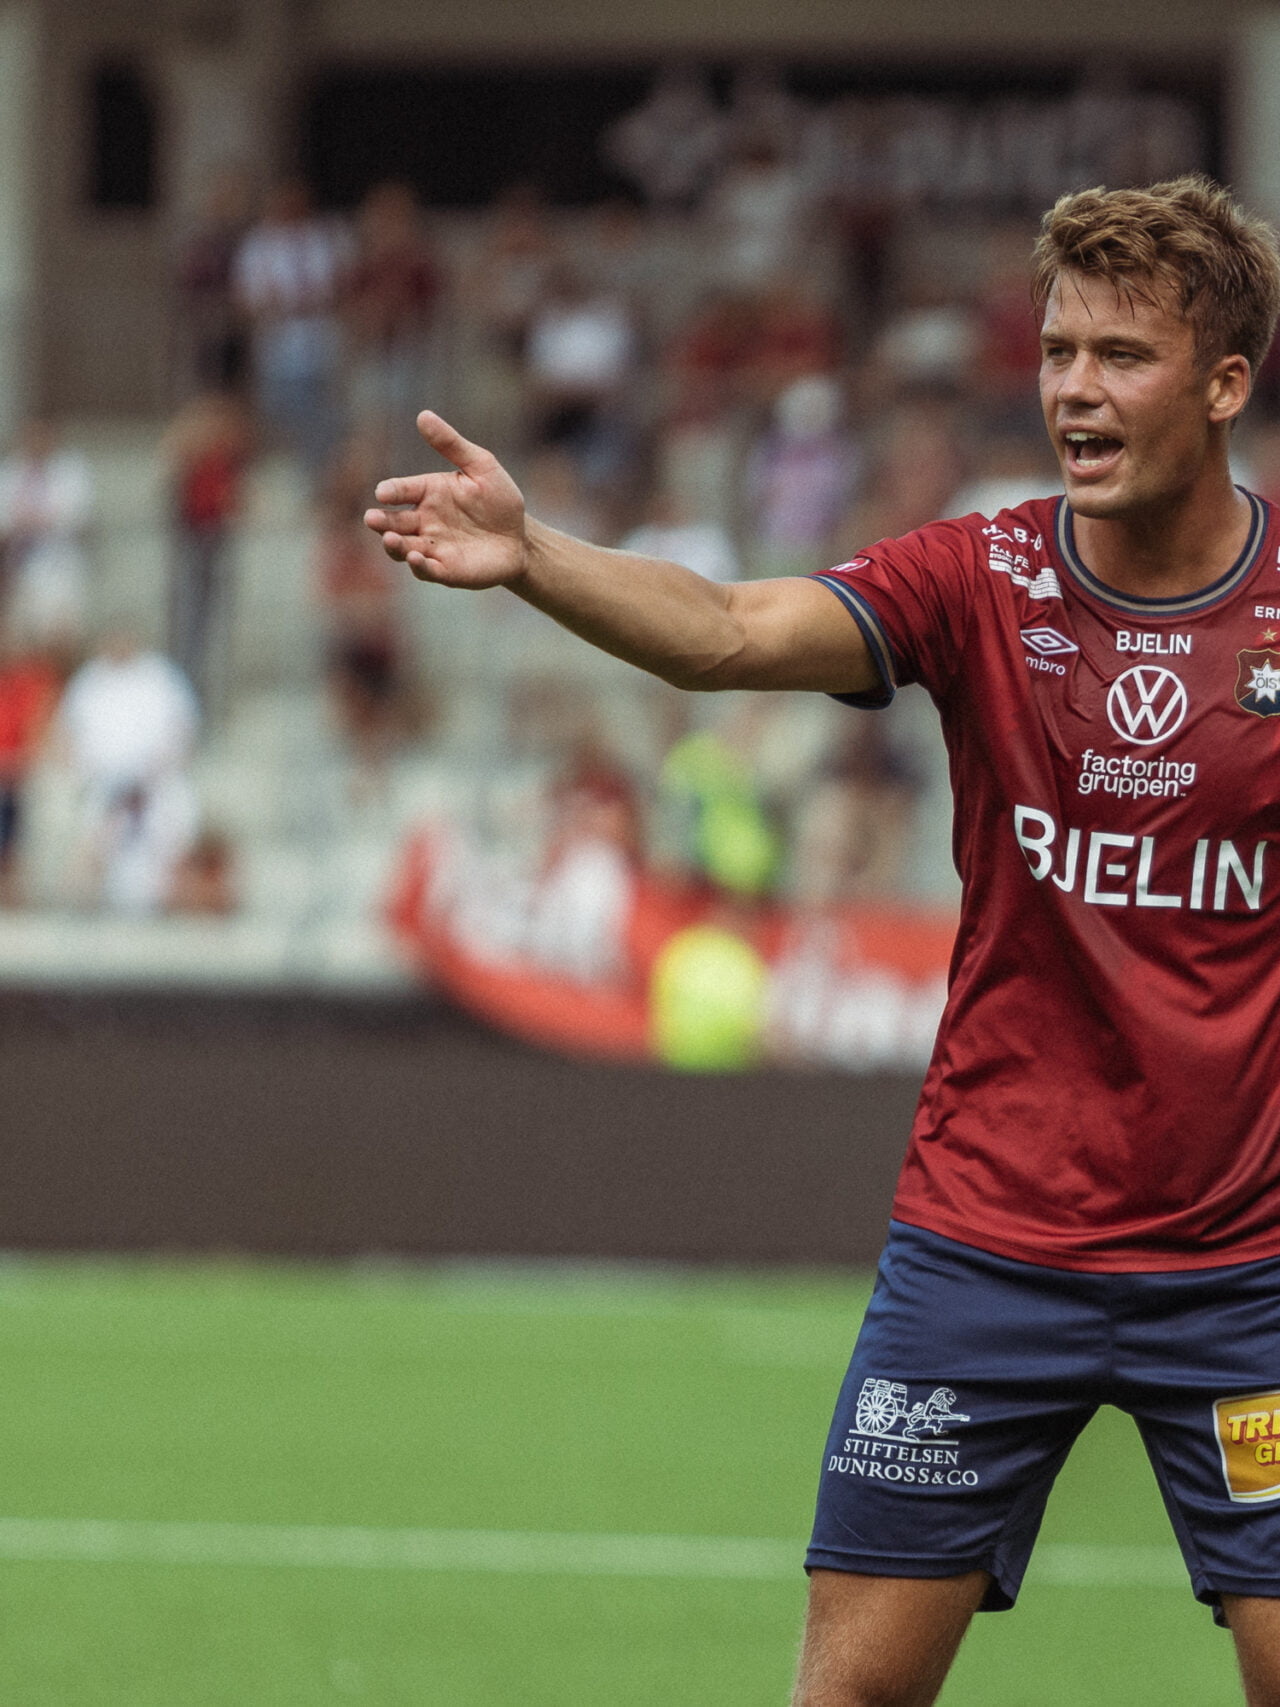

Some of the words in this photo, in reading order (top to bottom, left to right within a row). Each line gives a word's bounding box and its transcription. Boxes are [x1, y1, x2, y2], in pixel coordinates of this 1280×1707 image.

[1116, 630, 1193, 655] BJELIN
[1025, 655, 1067, 677] mbro
[1255, 672, 1278, 690] ÖIS
[1081, 749, 1196, 785] factoring
[1078, 772, 1180, 800] gruppen
[1014, 804, 1268, 910] BJELIN
[843, 1438, 959, 1466] STIFTELSEN
[828, 1455, 979, 1486] DUNROSS&CO
